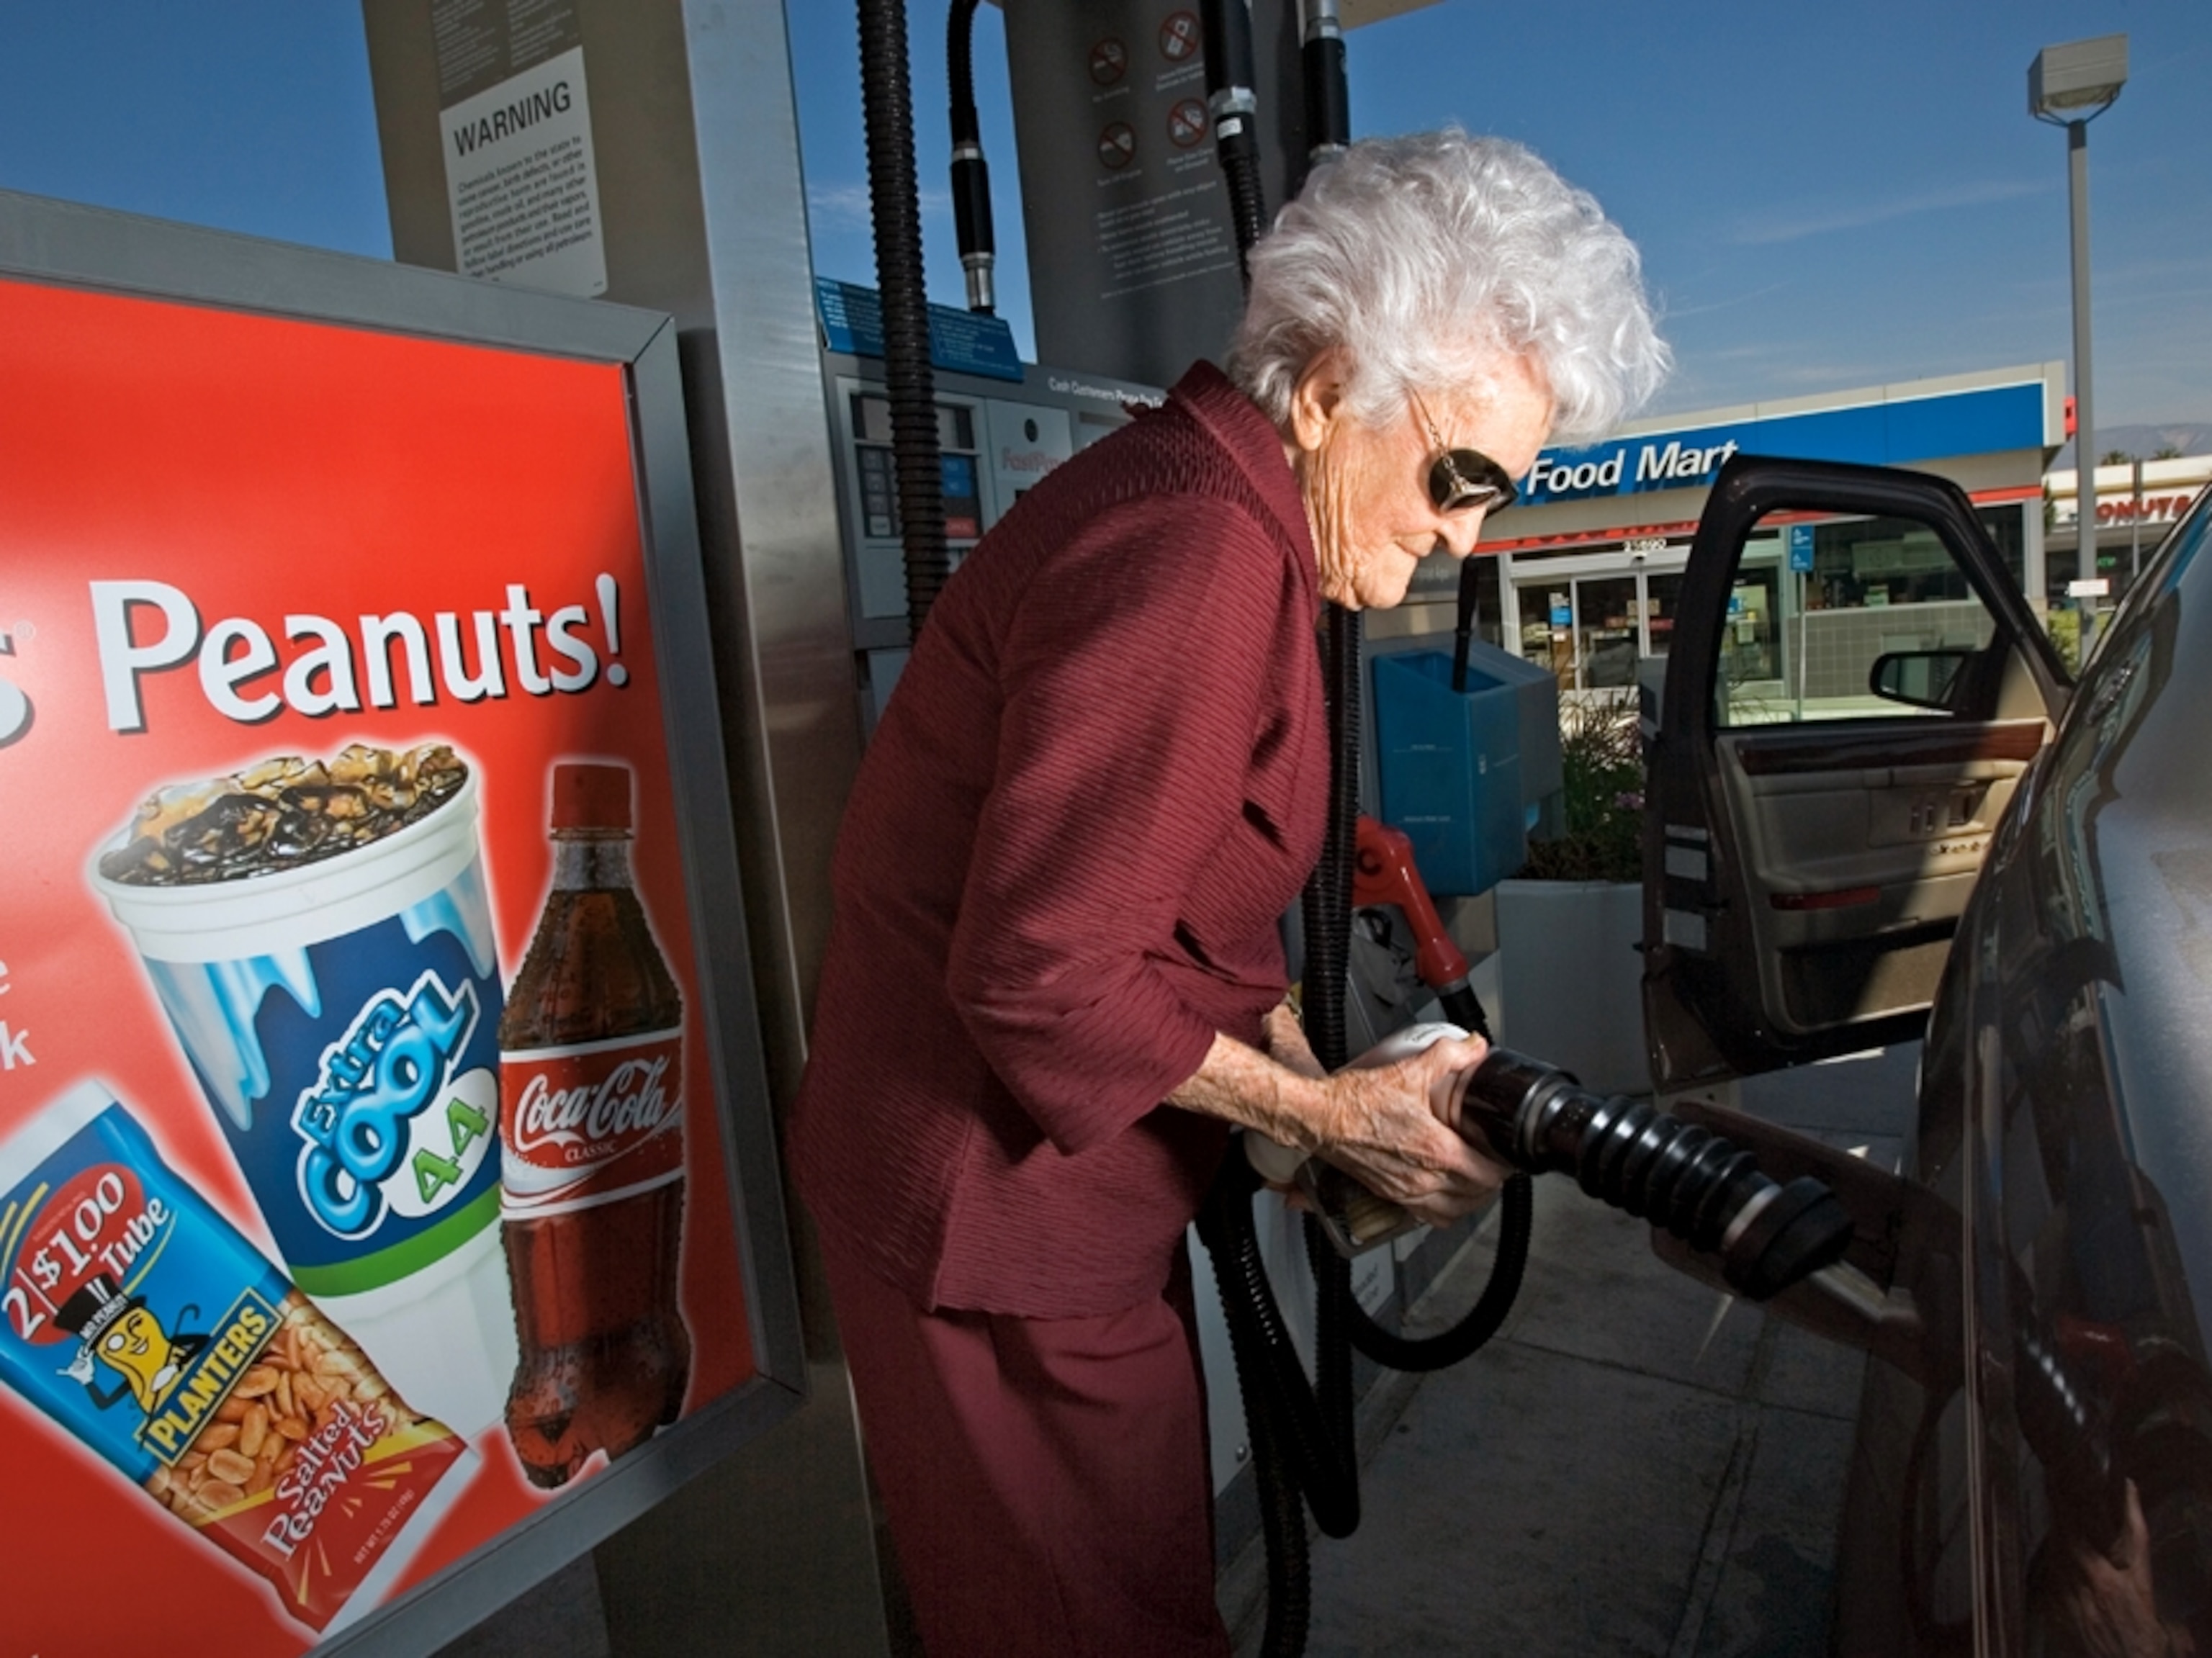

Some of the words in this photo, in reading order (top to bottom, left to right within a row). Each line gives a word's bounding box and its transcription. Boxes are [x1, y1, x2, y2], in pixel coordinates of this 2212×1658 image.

[454, 81, 571, 156] WARNING
[1527, 446, 1625, 495] Food
[1635, 438, 1738, 482] Mart
[2096, 495, 2191, 518] ONUTS
[88, 573, 628, 733] Peanuts!
[299, 996, 408, 1149] Extra
[305, 981, 474, 1233] COOL
[515, 1054, 670, 1153] Coca-Cola
[565, 1140, 617, 1162] CLASSIC
[99, 1197, 170, 1276] Tube
[148, 1306, 267, 1452] PLANTERS
[276, 1400, 352, 1510] Salted
